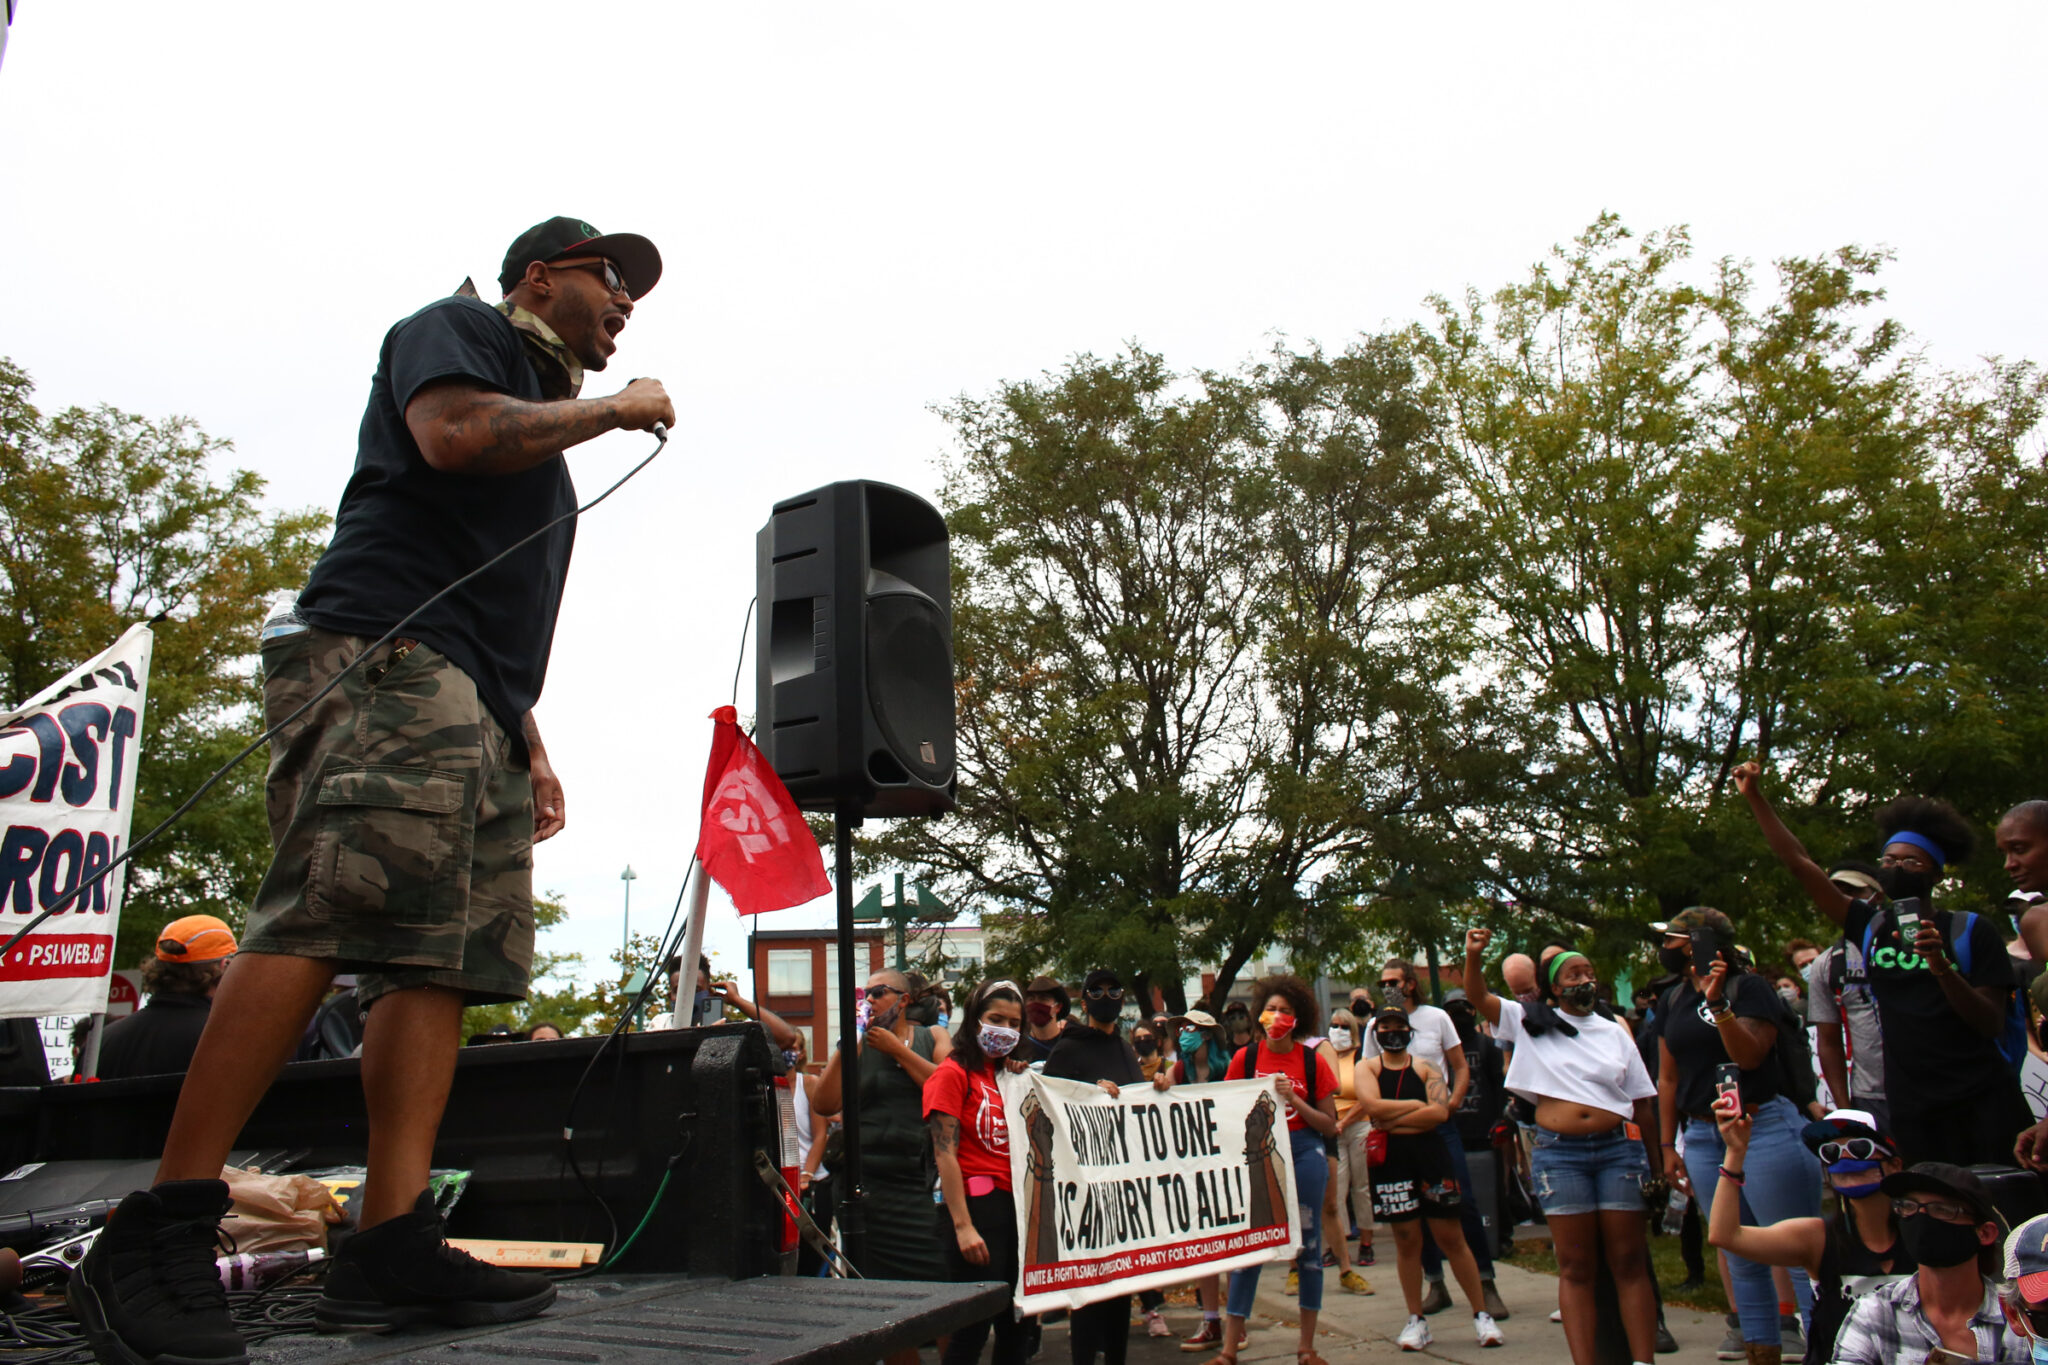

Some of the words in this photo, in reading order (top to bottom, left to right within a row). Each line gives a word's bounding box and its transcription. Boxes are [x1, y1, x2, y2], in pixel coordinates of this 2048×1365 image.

[110, 986, 129, 999] OT
[1131, 1103, 1168, 1162] TO
[1170, 1098, 1221, 1159] ONE
[1376, 1181, 1413, 1193] FUCK
[1380, 1192, 1409, 1203] THE
[1058, 1181, 1077, 1251] IS
[1157, 1173, 1190, 1234] TO
[1196, 1166, 1246, 1230] ALL!
[1025, 1269, 1046, 1287] UNITE
[1047, 1269, 1054, 1284] &
[1140, 1252, 1167, 1267] PARTY
[1168, 1248, 1185, 1262] FOR
[1185, 1239, 1227, 1258] SOCIALISM
[1228, 1236, 1243, 1250] AND
[1244, 1227, 1286, 1247] LIBERATION
